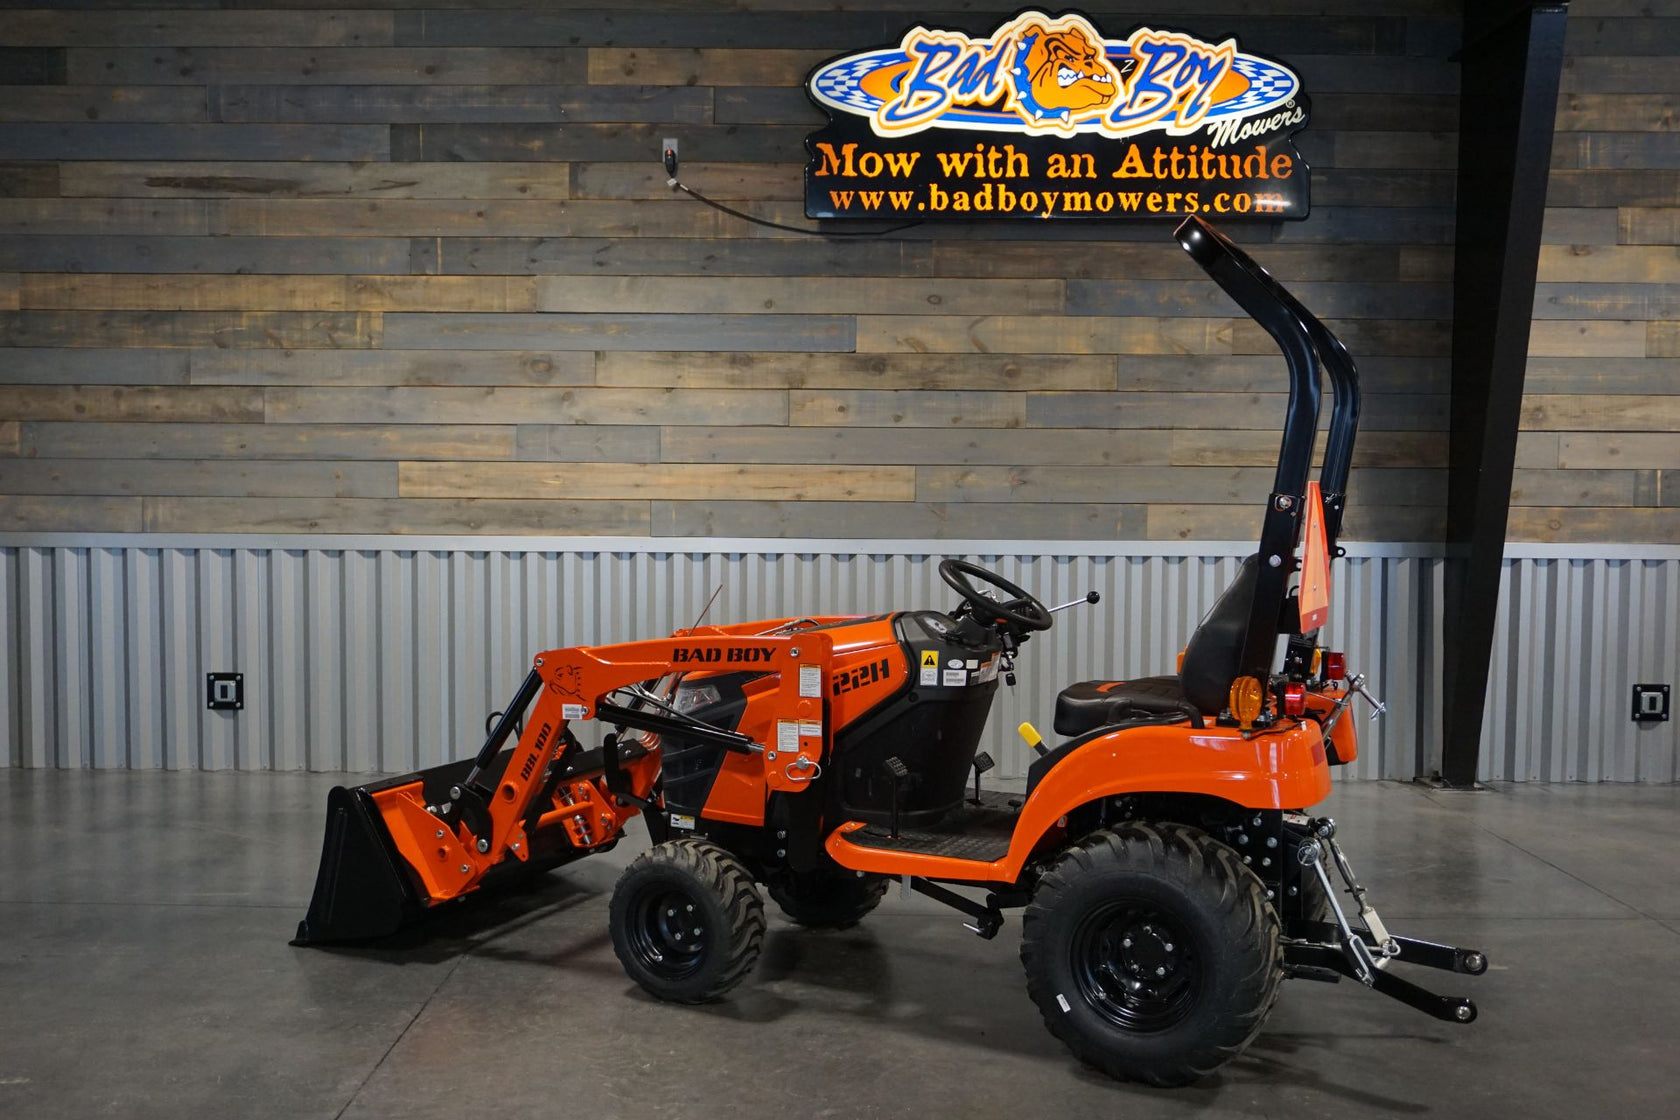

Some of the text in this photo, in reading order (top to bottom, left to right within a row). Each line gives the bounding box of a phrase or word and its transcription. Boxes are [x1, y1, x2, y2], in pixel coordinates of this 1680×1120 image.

[882, 36, 1231, 126] Bad Boy
[1207, 105, 1305, 149] Mowers
[815, 142, 1293, 179] Mow with an Attitude
[829, 182, 1285, 219] www.badboymowers.com
[672, 647, 777, 662] BAD BOY
[832, 658, 890, 696] 22H
